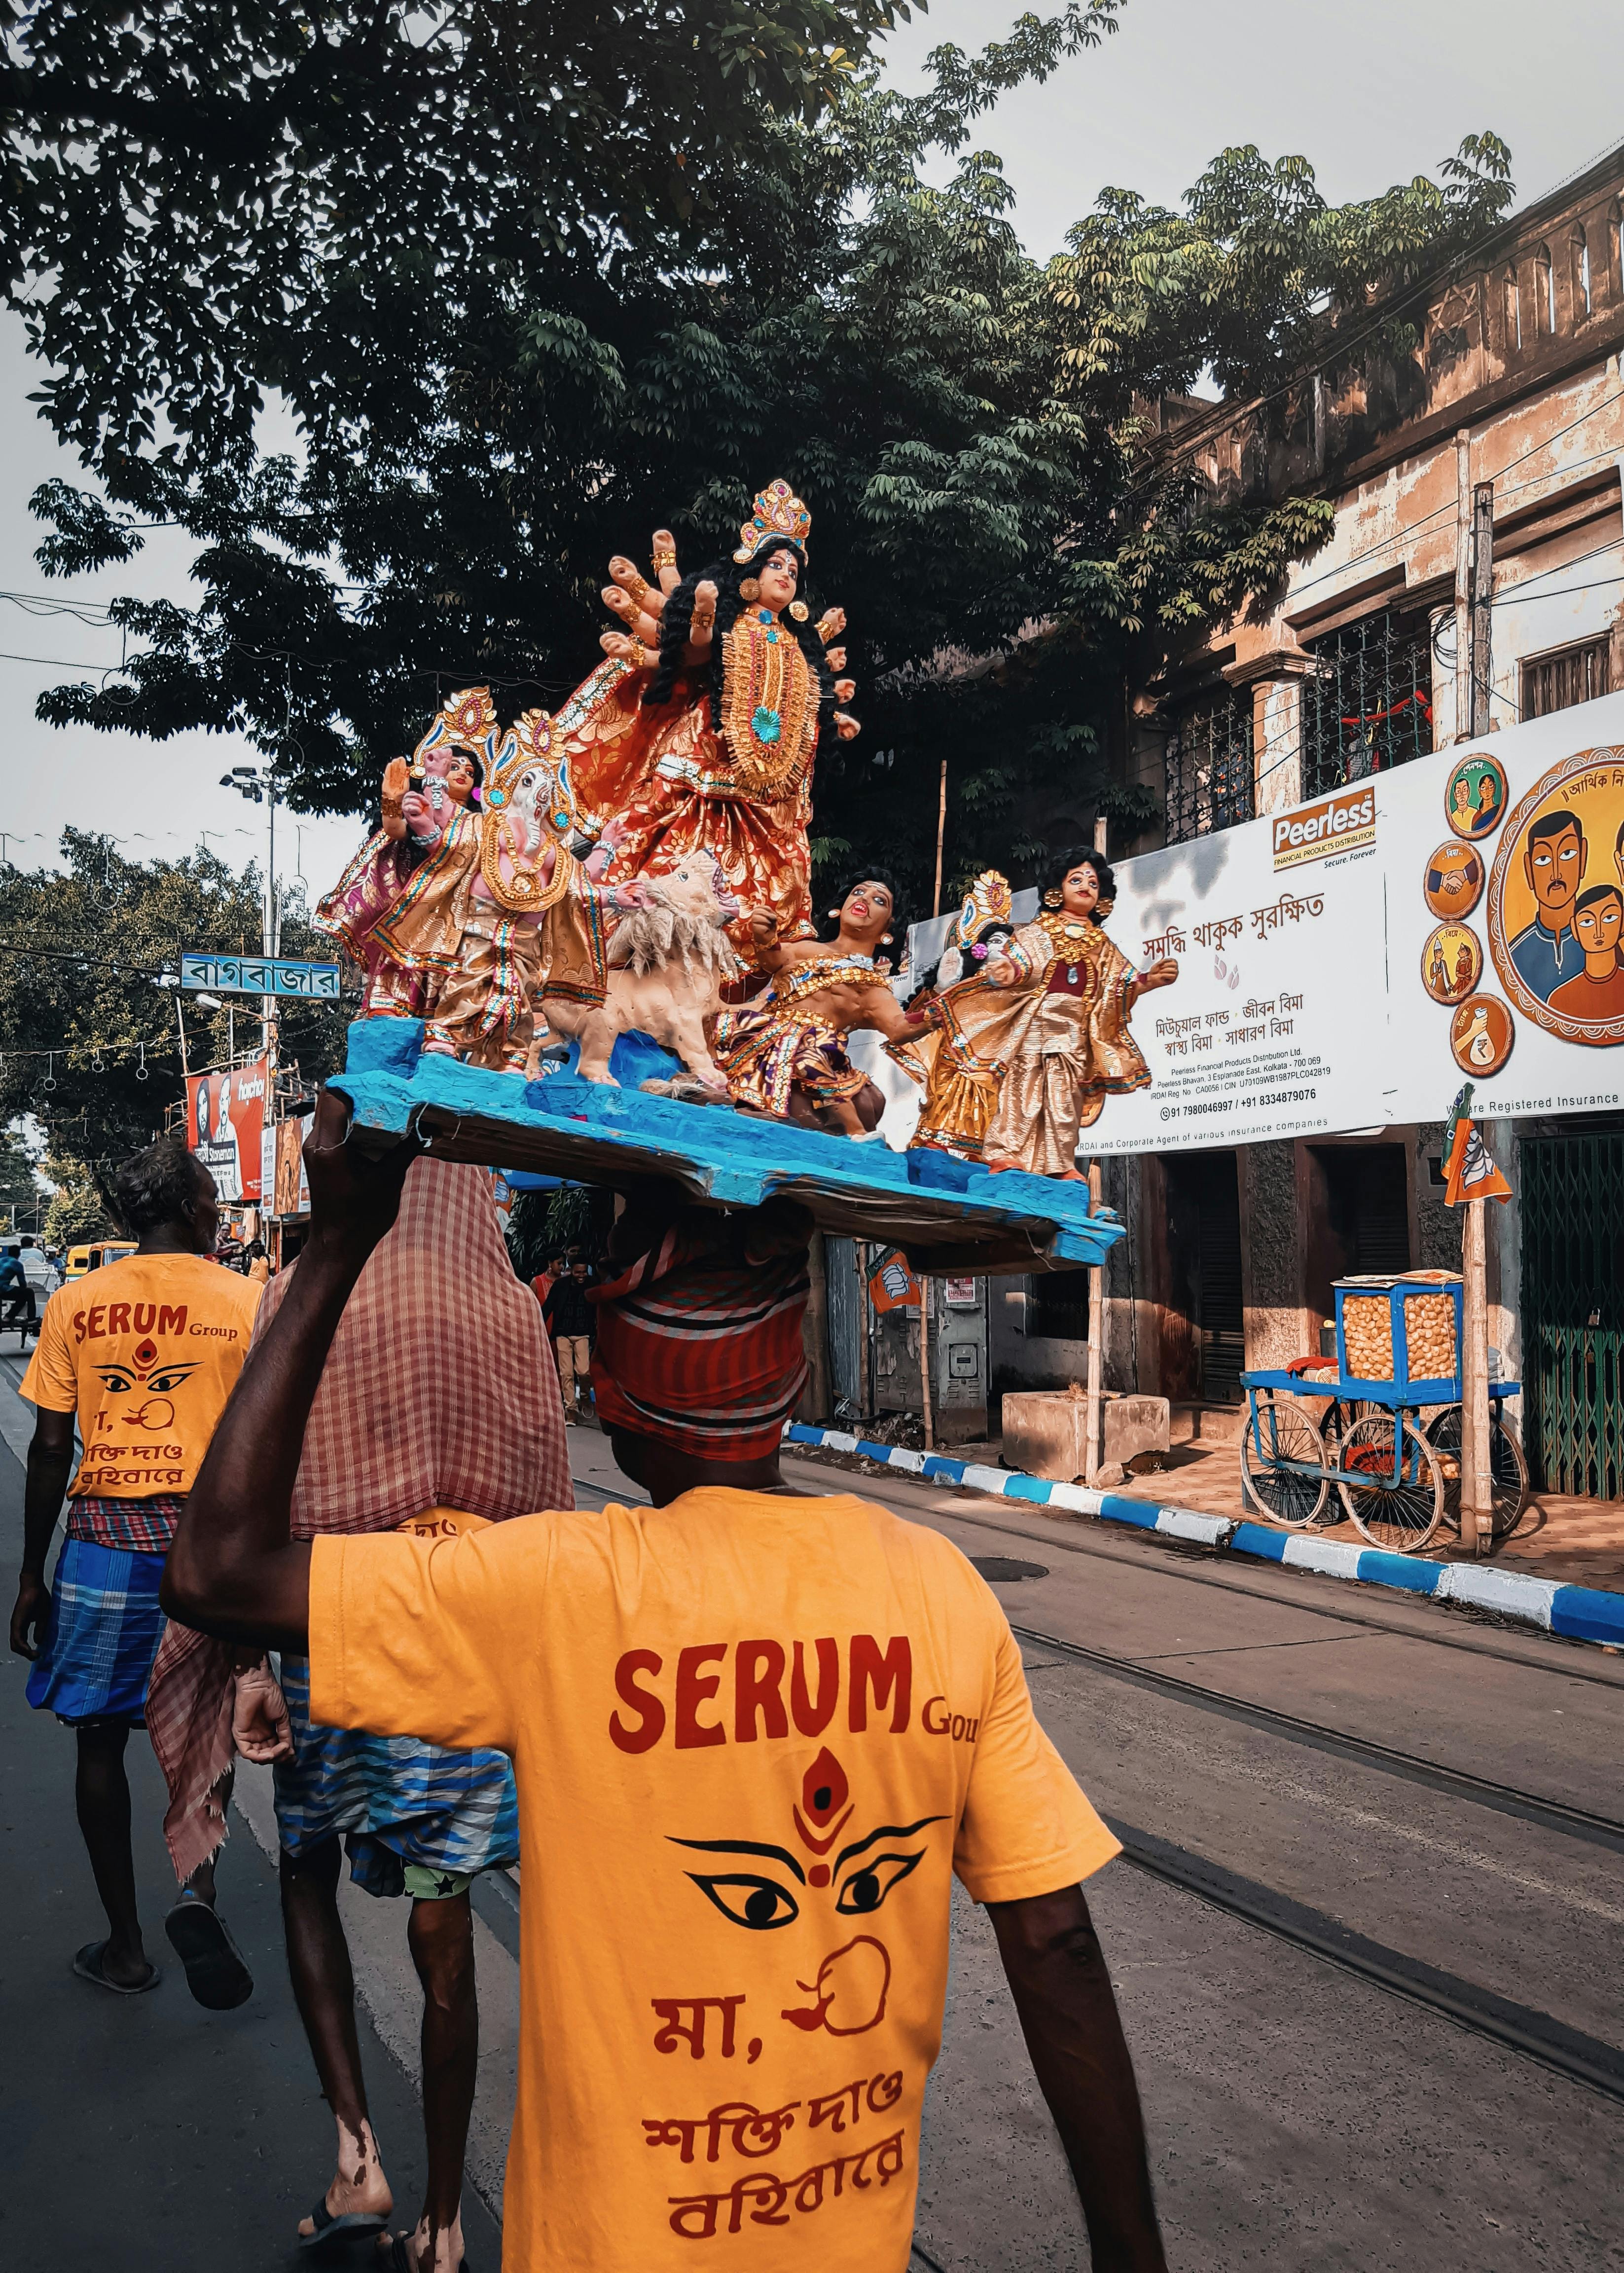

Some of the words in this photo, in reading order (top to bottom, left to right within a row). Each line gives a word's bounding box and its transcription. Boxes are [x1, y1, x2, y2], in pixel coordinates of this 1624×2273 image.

[1275, 800, 1373, 851] Peerless
[1274, 852, 1302, 866] FINANCIAL
[1303, 843, 1334, 856] PRODUCTS
[1335, 830, 1375, 847] DISTRIBUTION
[1324, 857, 1348, 868] Secure.
[1350, 849, 1376, 861] Forever
[1193, 915, 1243, 951] থাকুক
[1250, 893, 1325, 940] সুরক্ষিত
[185, 957, 337, 994] বাগবাজার
[1156, 1017, 1201, 1038] মিউচুয়াল
[1205, 1011, 1229, 1027] ফান্ড
[1242, 999, 1275, 1018] জীবন
[1279, 992, 1303, 1013] বিমা
[1165, 1040, 1188, 1056] স্বাস্থ্য
[1191, 1033, 1213, 1052] বিমা
[1225, 1024, 1265, 1045] সাধারণ
[1270, 1018, 1294, 1037] বিমা
[1157, 1080, 1181, 1088] Peerless
[1183, 1076, 1206, 1085] Bhavan,
[1213, 1069, 1244, 1081] Esplanade
[1263, 1063, 1287, 1072] Kolkata
[1294, 1059, 1306, 1067] 700
[1308, 1056, 1321, 1065] 069
[1171, 1067, 1195, 1076] Peerless
[1197, 1062, 1223, 1072] Financial
[1225, 1057, 1251, 1067] Products
[1253, 1051, 1288, 1063] Distribution
[1290, 1047, 1302, 1056] Ltd.
[1151, 1092, 1166, 1100] IRDAI
[1195, 1084, 1219, 1094] CA0056
[1240, 1066, 1331, 1087] U70109WB1987PLC042819
[1183, 1100, 1233, 1116] 7980046997
[1241, 1097, 1256, 1107] +91
[1260, 1089, 1316, 1105] 8334879076
[1490, 1100, 1552, 1113] Registered
[1557, 1094, 1619, 1106] Insurance
[1117, 1139, 1154, 1148] Corporate
[1156, 1135, 1179, 1145] Agent
[1194, 1130, 1225, 1140] various
[1228, 1125, 1272, 1137] insurance
[1276, 1118, 1328, 1131] companies
[209, 1148, 235, 1162] Stoneman
[73, 1302, 187, 1345] SERUM
[189, 1323, 238, 1342] Group
[132, 1444, 182, 1460] দাও
[609, 1635, 912, 1754] SERUM
[651, 1994, 762, 2064] মা,
[642, 2102, 801, 2163] শক্তি
[808, 2070, 903, 2132] দাও
